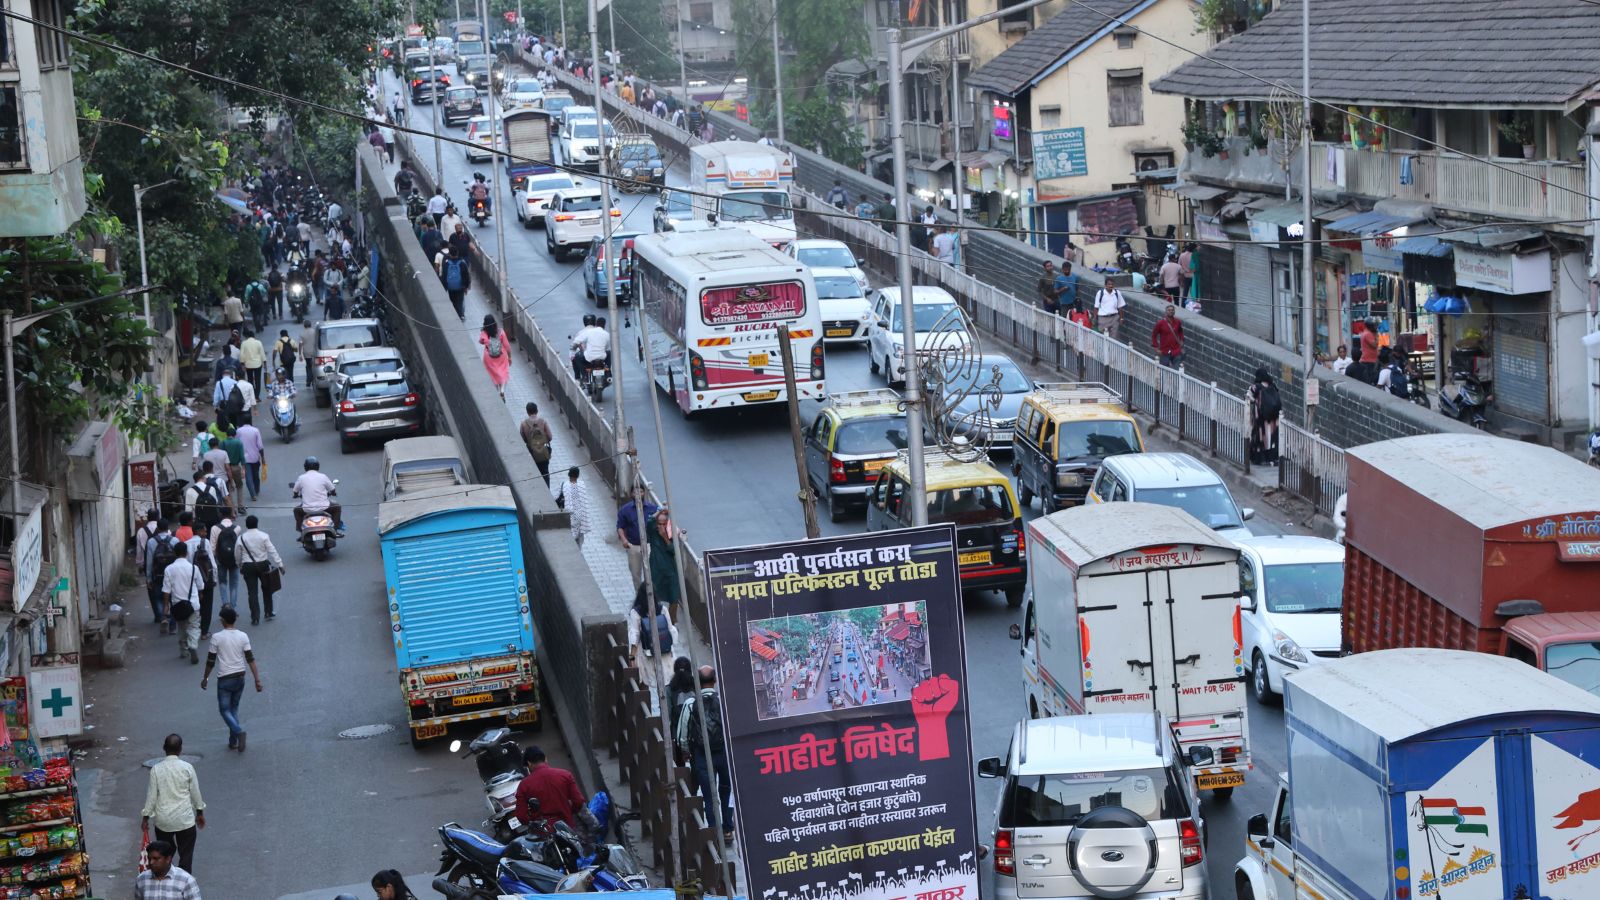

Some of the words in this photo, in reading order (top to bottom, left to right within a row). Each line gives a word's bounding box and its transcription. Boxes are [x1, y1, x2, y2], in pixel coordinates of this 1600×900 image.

[735, 322, 778, 332] RUCHA
[802, 547, 873, 576] पुनर्वसन
[875, 544, 912, 563] करा
[1126, 557, 1142, 568] जय
[1144, 552, 1181, 567] महाराष्ट्र
[724, 581, 768, 600] मगच
[862, 567, 894, 591] पूल
[898, 560, 938, 581] तोडा
[1182, 686, 1201, 696] WAIT
[1204, 684, 1218, 694] FOR
[1219, 683, 1235, 692] SIDE
[754, 733, 838, 775] जाहीर
[842, 723, 916, 763] निषेद
[782, 796, 802, 807] १५०
[803, 787, 846, 804] वर्षापासून
[890, 774, 927, 789] स्थानिक
[764, 828, 790, 843] पहिले
[791, 821, 827, 842] पुनर्वसन
[828, 818, 847, 832] करा
[847, 813, 880, 829] नाहीतर
[881, 808, 917, 825] रस्त्यावर
[790, 803, 835, 823] रहिवाशांचे
[859, 797, 882, 812] हजार
[768, 852, 808, 875] जाहीर
[811, 844, 864, 867] आंदोलन
[865, 834, 920, 858] करण्यात
[922, 826, 956, 849] येईल
[1418, 878, 1438, 896] मेरा
[1440, 866, 1468, 885] भारत
[1469, 853, 1495, 873] महान
[1546, 867, 1566, 883] जय
